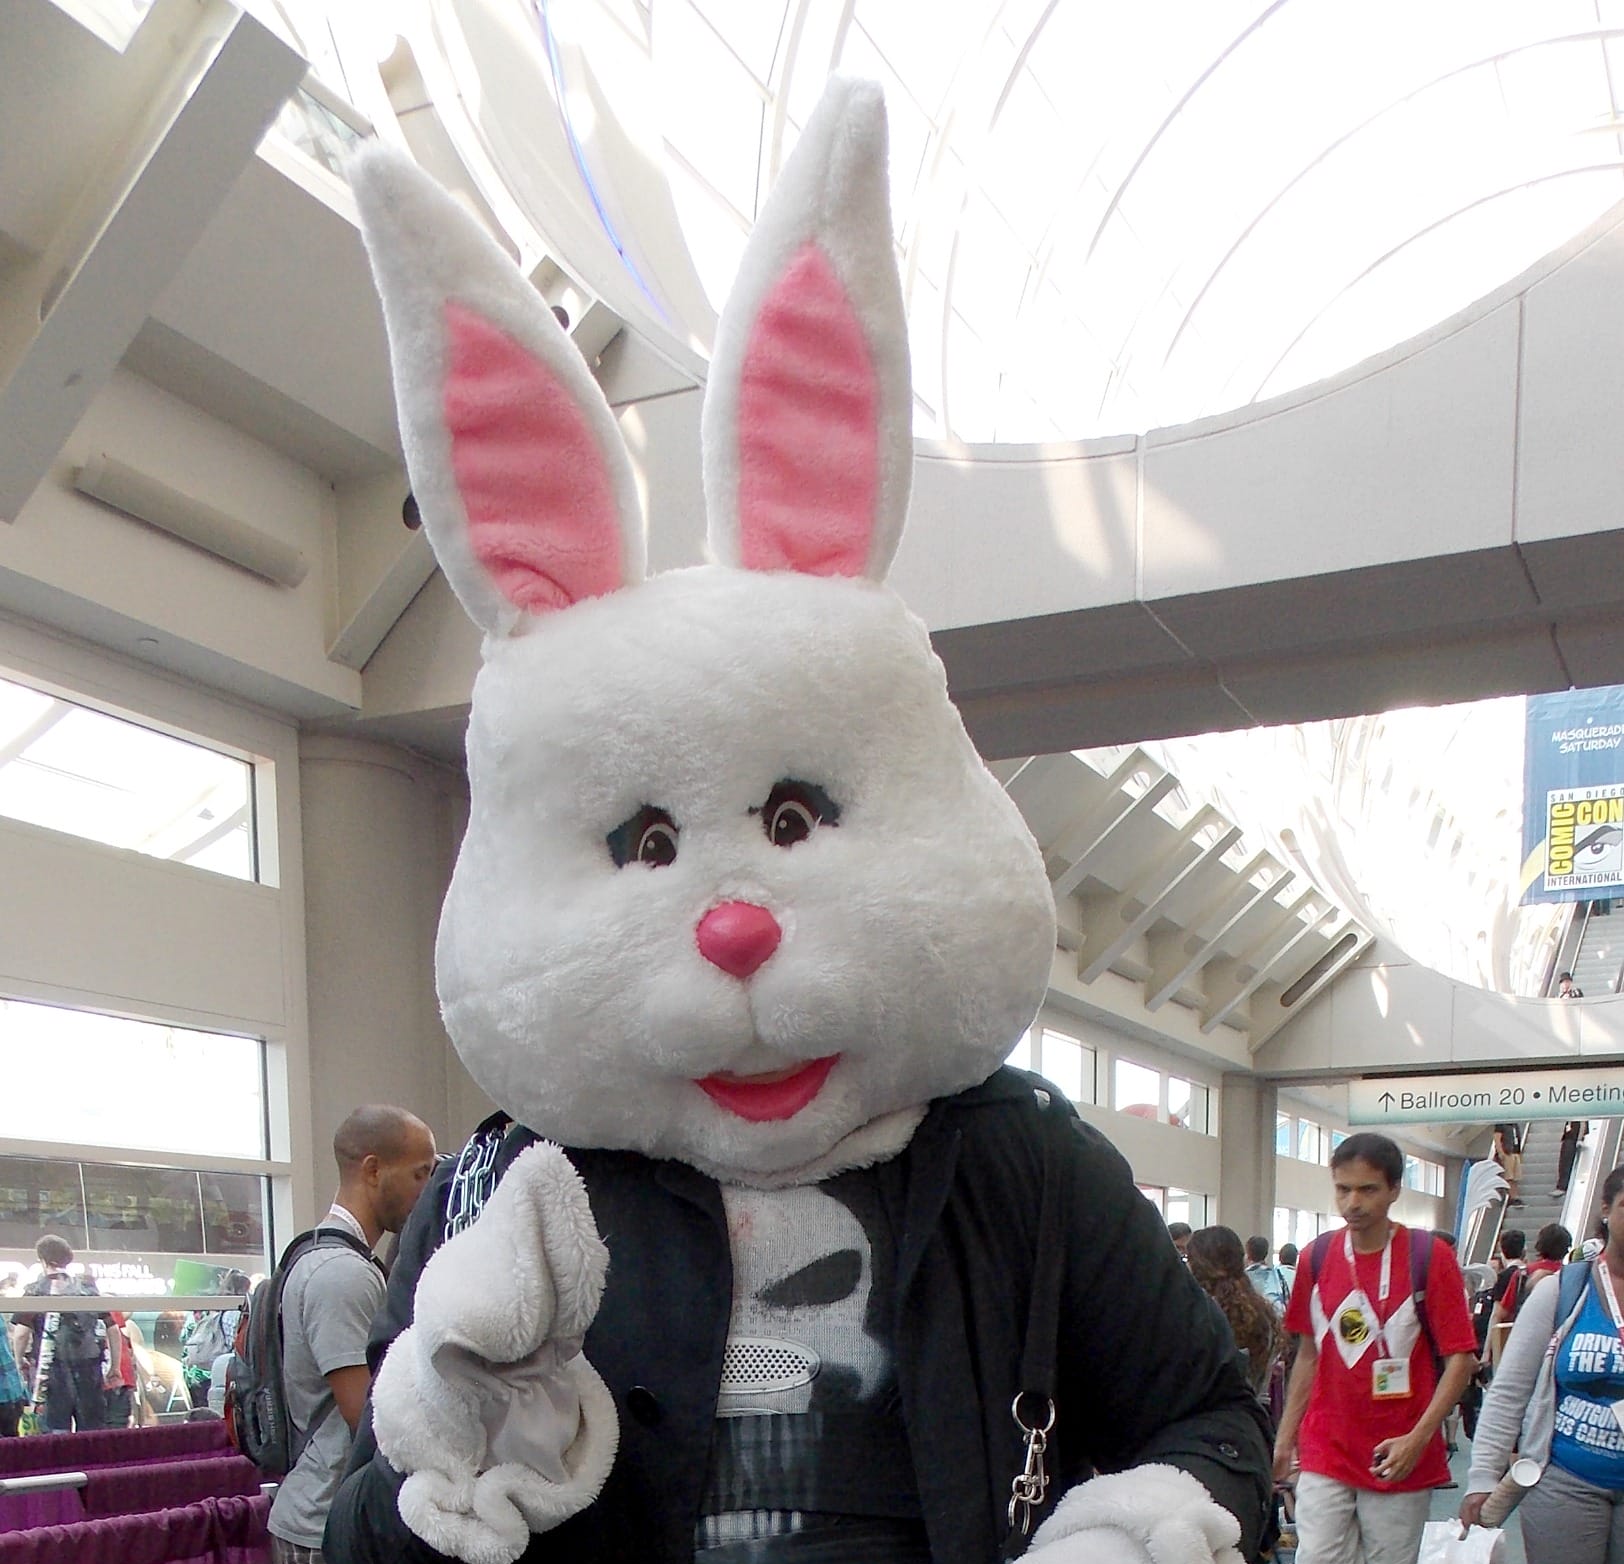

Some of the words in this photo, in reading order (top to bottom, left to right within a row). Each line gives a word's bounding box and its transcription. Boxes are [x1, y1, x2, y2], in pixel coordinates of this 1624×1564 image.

[1559, 737, 1621, 754] SATURDAY
[1550, 793, 1574, 802] SAN
[1576, 798, 1624, 825] CON
[1549, 803, 1575, 875] COMIC
[1547, 871, 1622, 887] INTERNATIONAL
[1400, 1092, 1491, 1109] Ballroom
[1499, 1088, 1525, 1105] 20
[1549, 1083, 1624, 1104] Meetin
[121, 1263, 154, 1278] FALL
[1571, 1333, 1624, 1354] DRIVE
[1568, 1351, 1607, 1373] THE
